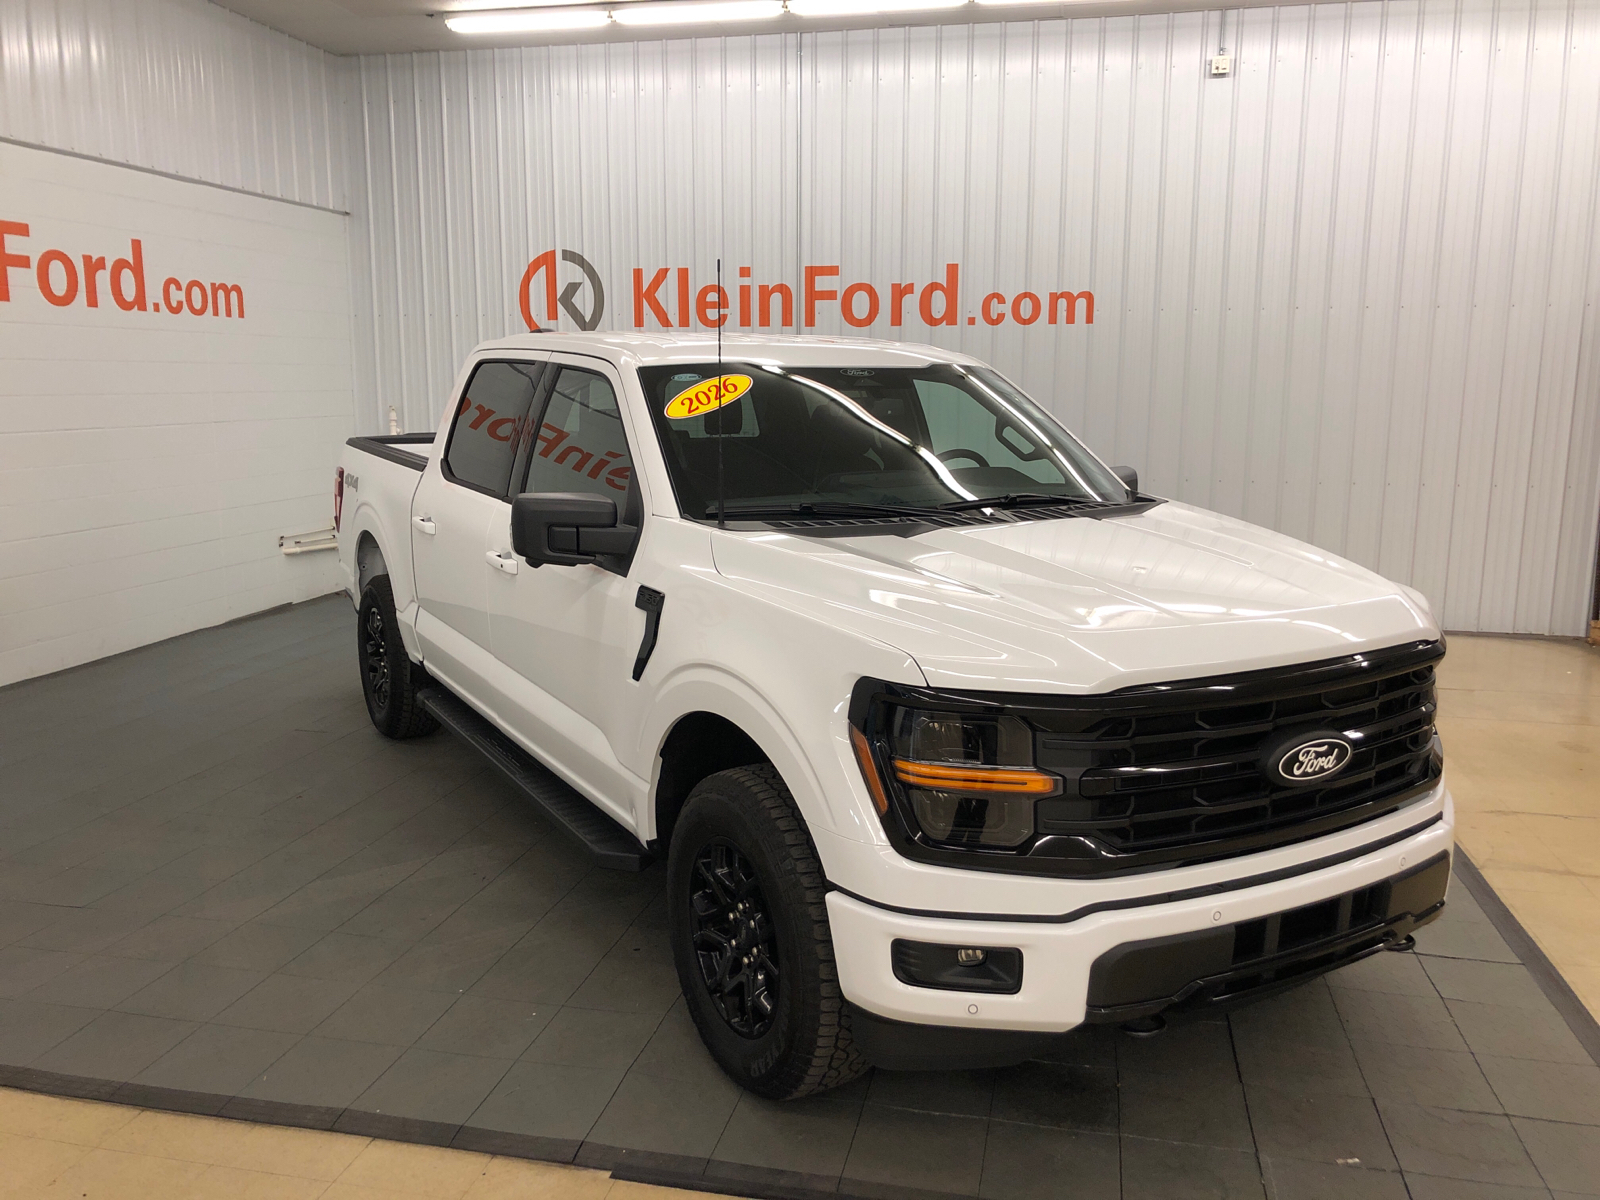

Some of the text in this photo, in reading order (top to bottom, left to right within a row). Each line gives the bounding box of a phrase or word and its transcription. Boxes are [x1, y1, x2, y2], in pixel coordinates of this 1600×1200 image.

[632, 263, 1095, 328] KleinFord.com
[680, 377, 738, 415] 2026
[1293, 744, 1339, 776] Ford
